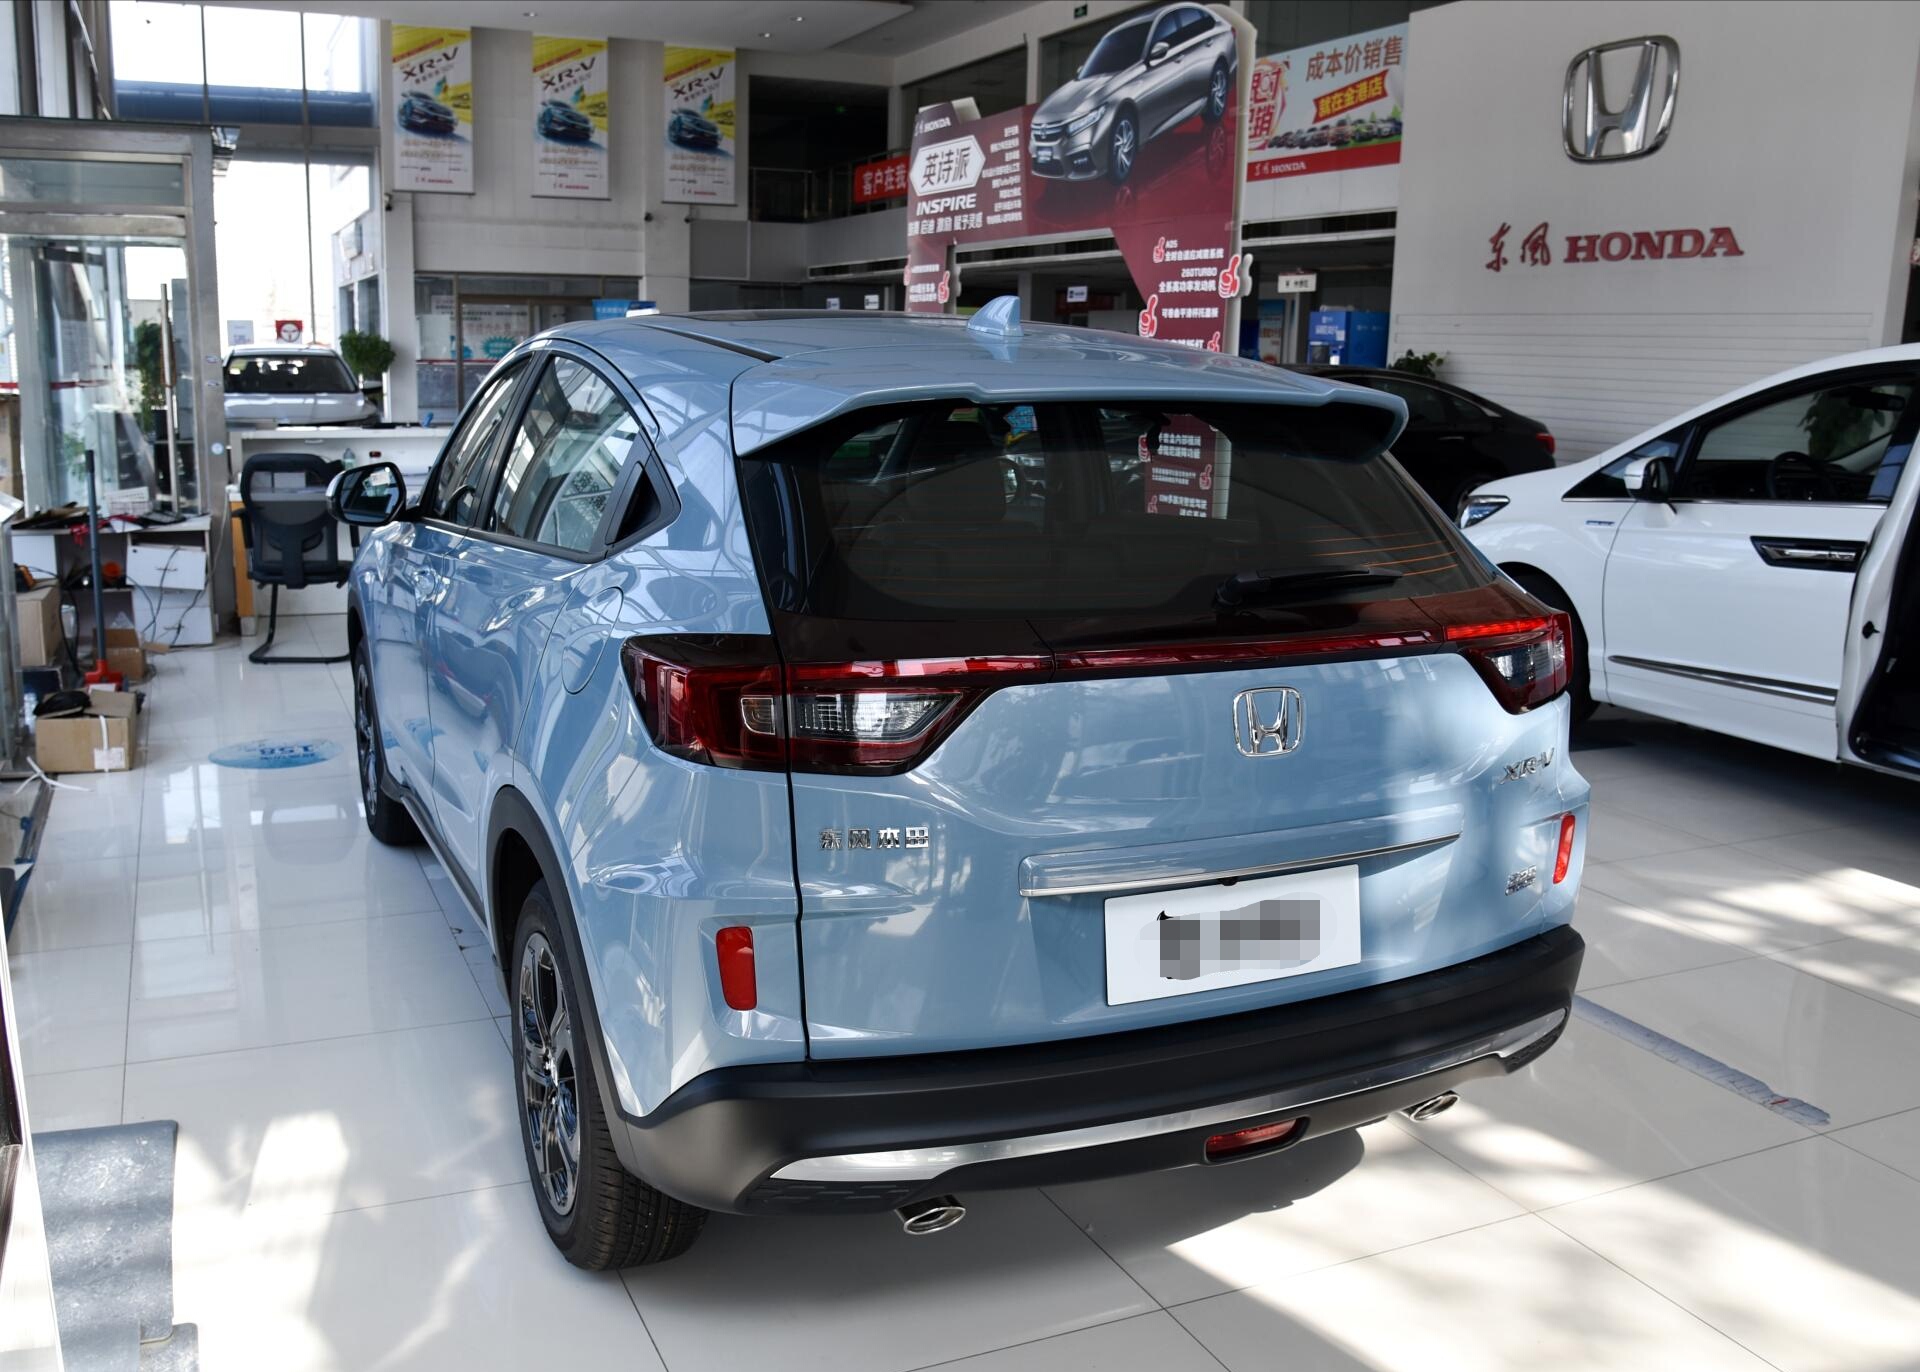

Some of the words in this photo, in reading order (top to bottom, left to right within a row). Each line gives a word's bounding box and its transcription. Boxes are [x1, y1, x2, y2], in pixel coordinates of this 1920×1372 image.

[403, 46, 458, 81] XR-V
[542, 57, 595, 90] XR-V
[1306, 35, 1403, 82] 成本价销售
[674, 66, 724, 99] XR-V
[921, 147, 971, 188] 英诗派
[1271, 161, 1306, 174] HONDA
[916, 193, 977, 216] INSPIRE
[1486, 222, 1551, 272] 东风
[1563, 227, 1744, 264] HONDA
[1500, 747, 1555, 785] XR-V
[819, 826, 930, 849] 东风本田
